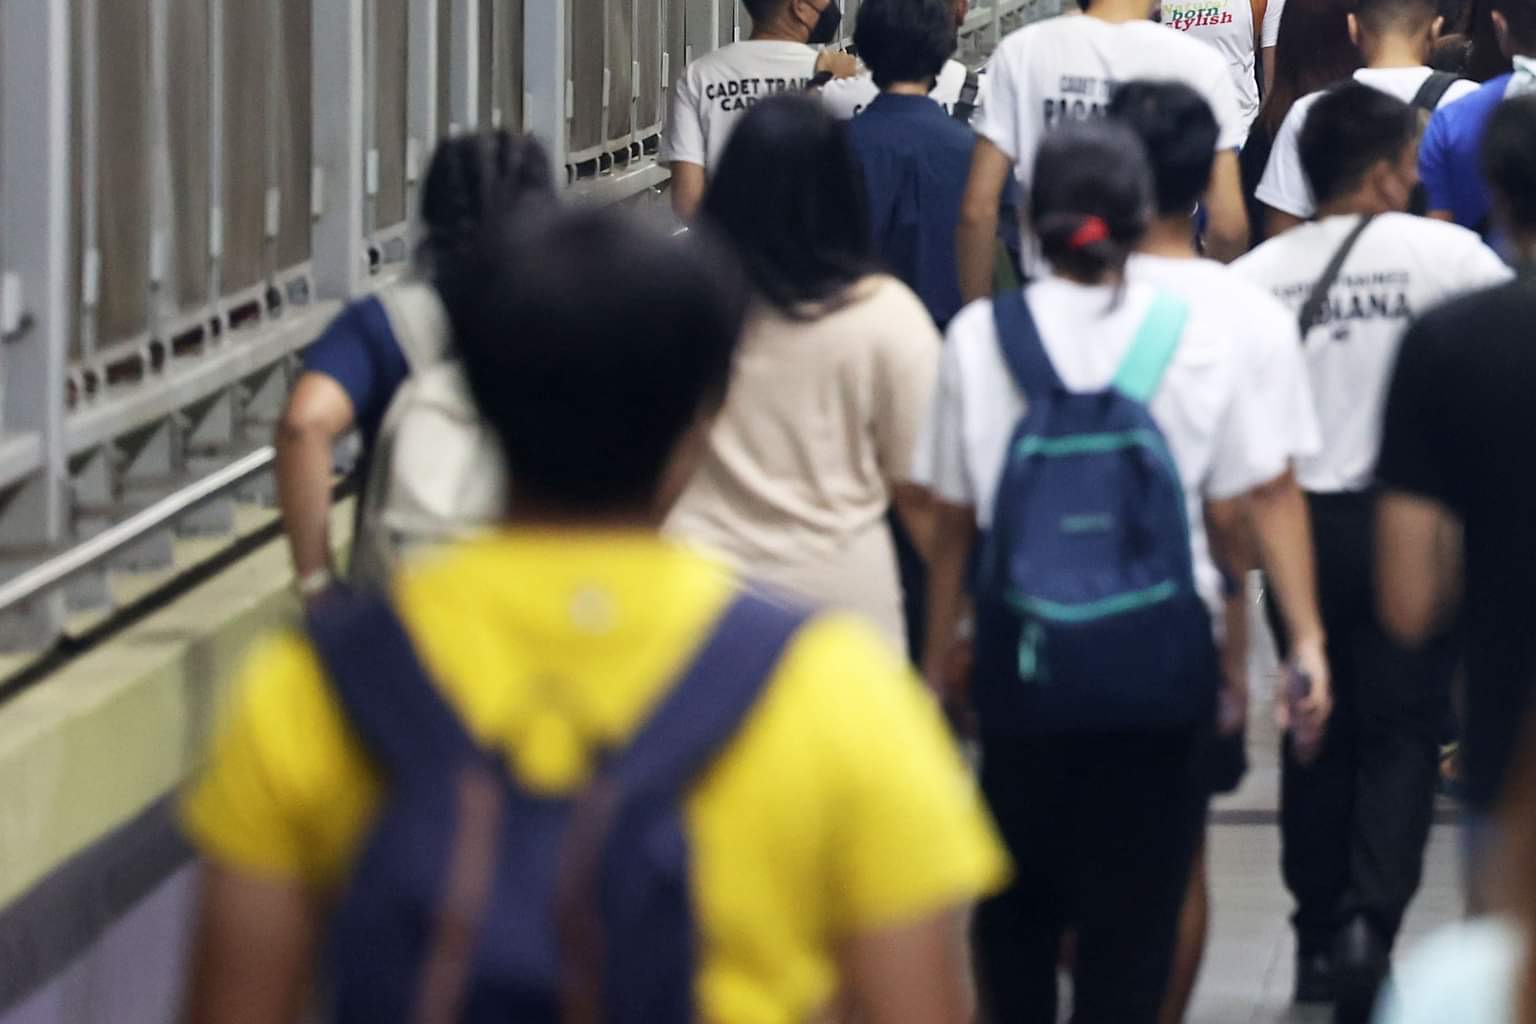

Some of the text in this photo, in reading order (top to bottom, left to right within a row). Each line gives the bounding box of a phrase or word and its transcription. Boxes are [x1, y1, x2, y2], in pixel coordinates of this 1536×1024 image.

[1172, 7, 1219, 21] born
[706, 78, 760, 100] CADET
[721, 97, 758, 112] CAD
